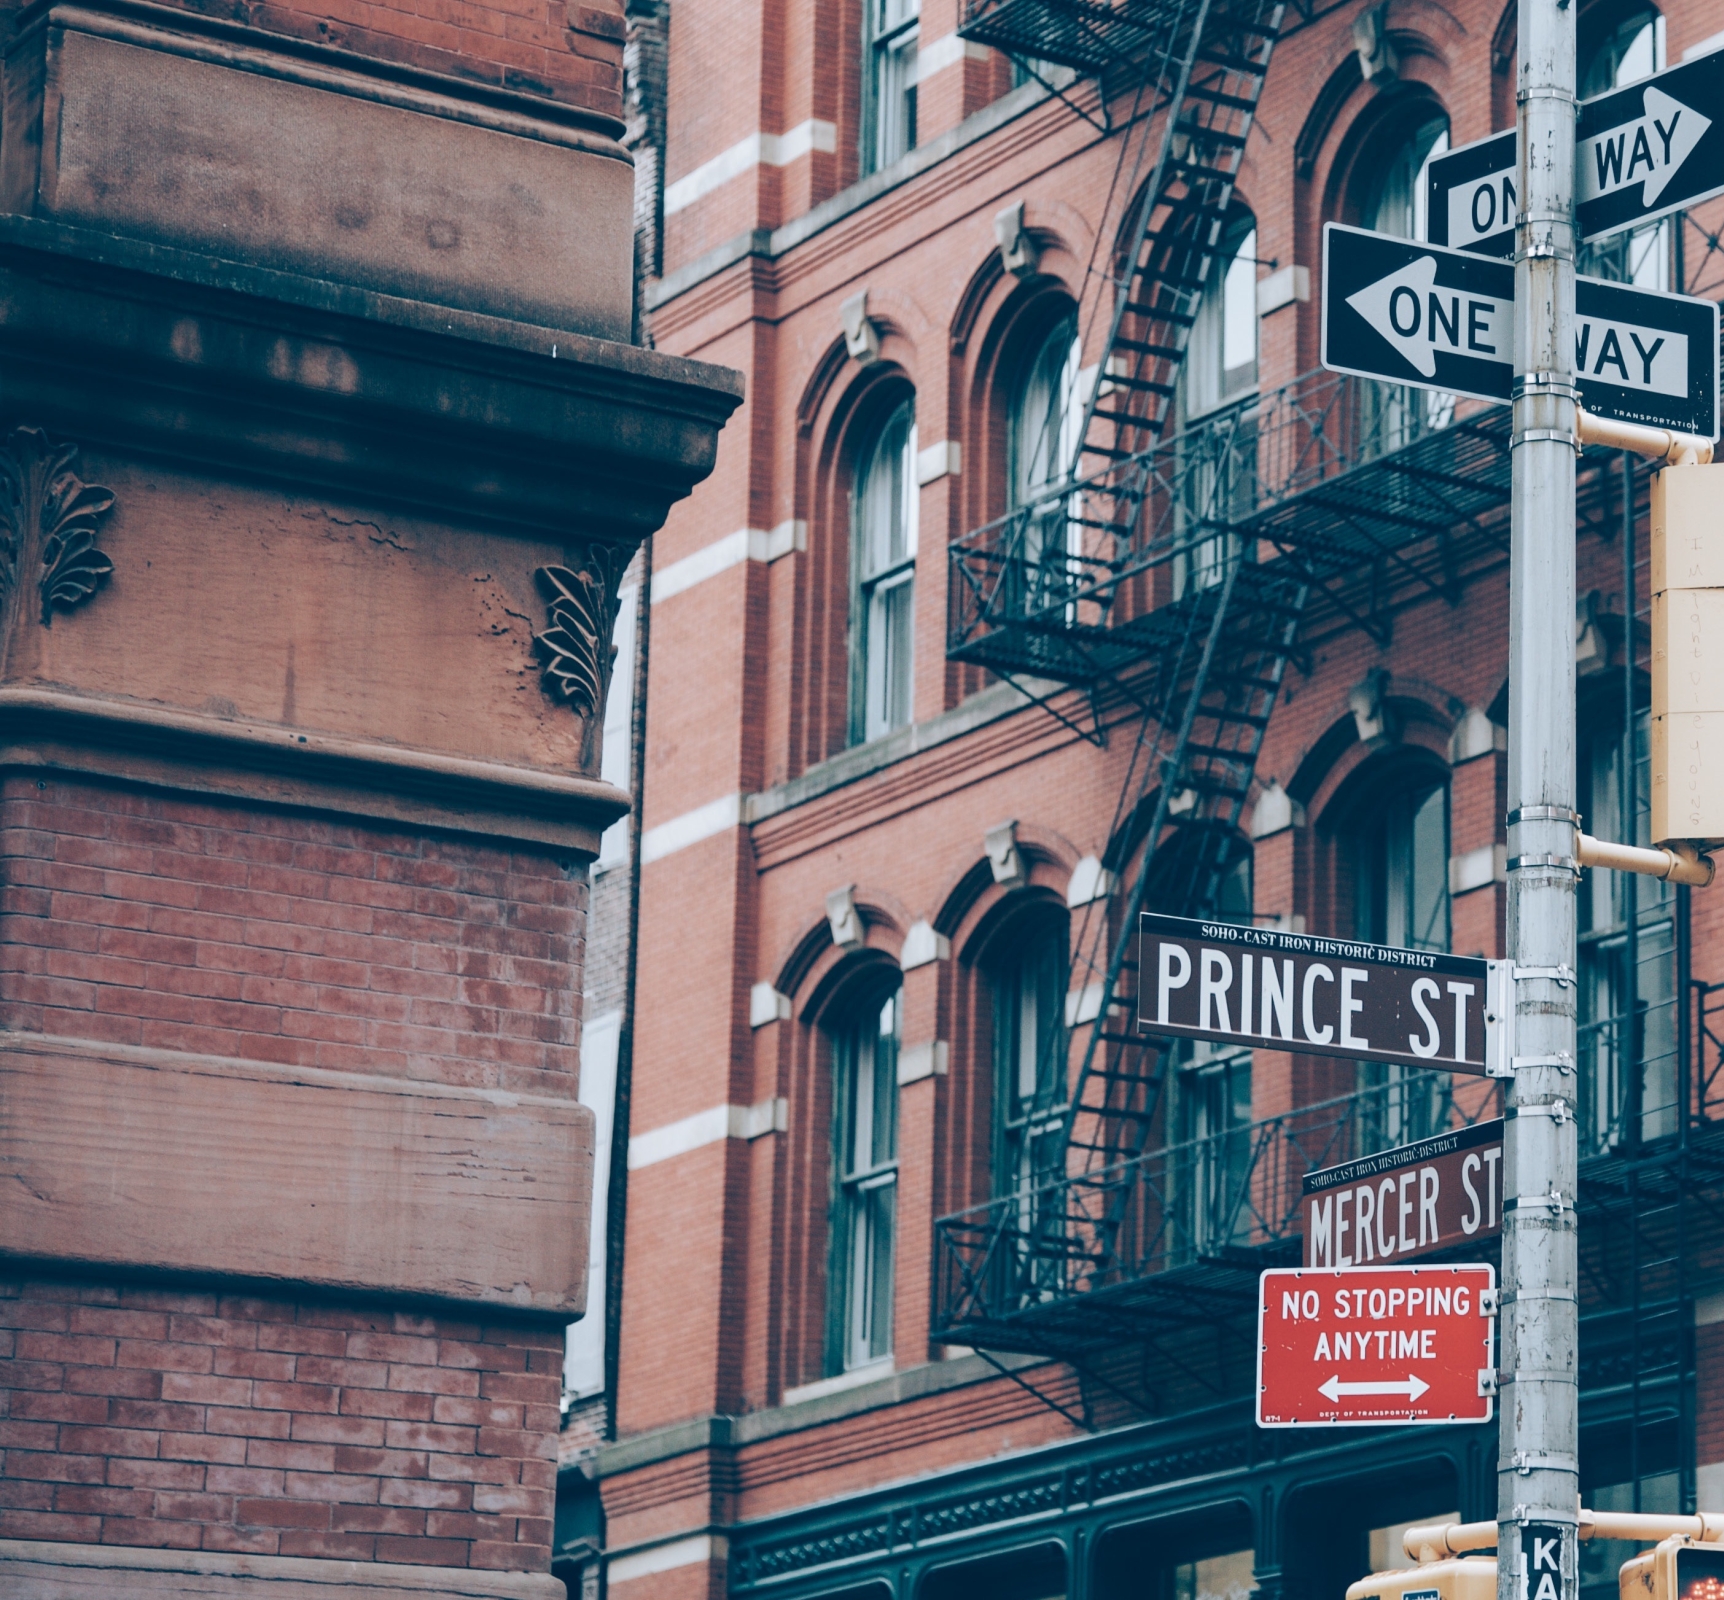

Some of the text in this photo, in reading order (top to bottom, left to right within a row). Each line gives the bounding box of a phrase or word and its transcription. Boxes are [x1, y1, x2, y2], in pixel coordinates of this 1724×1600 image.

[1471, 110, 1682, 234] ON WAY
[1389, 285, 1496, 355] ONE
[1590, 404, 1699, 430] OF TRANSPORTATION
[1201, 924, 1437, 969] SOHO-CAST IRON HISTORIC DISTRICT
[1157, 942, 1475, 1062] PRINCE ST
[1310, 1166, 1355, 1189] SOHO-CAST
[1356, 1160, 1378, 1176] IRON
[1310, 1147, 1502, 1268] MERCER ST
[1282, 1287, 1470, 1320] NO STOPPING
[1313, 1330, 1437, 1362] ANYTIME
[1357, 1409, 1429, 1417] TRANSPORTATION
